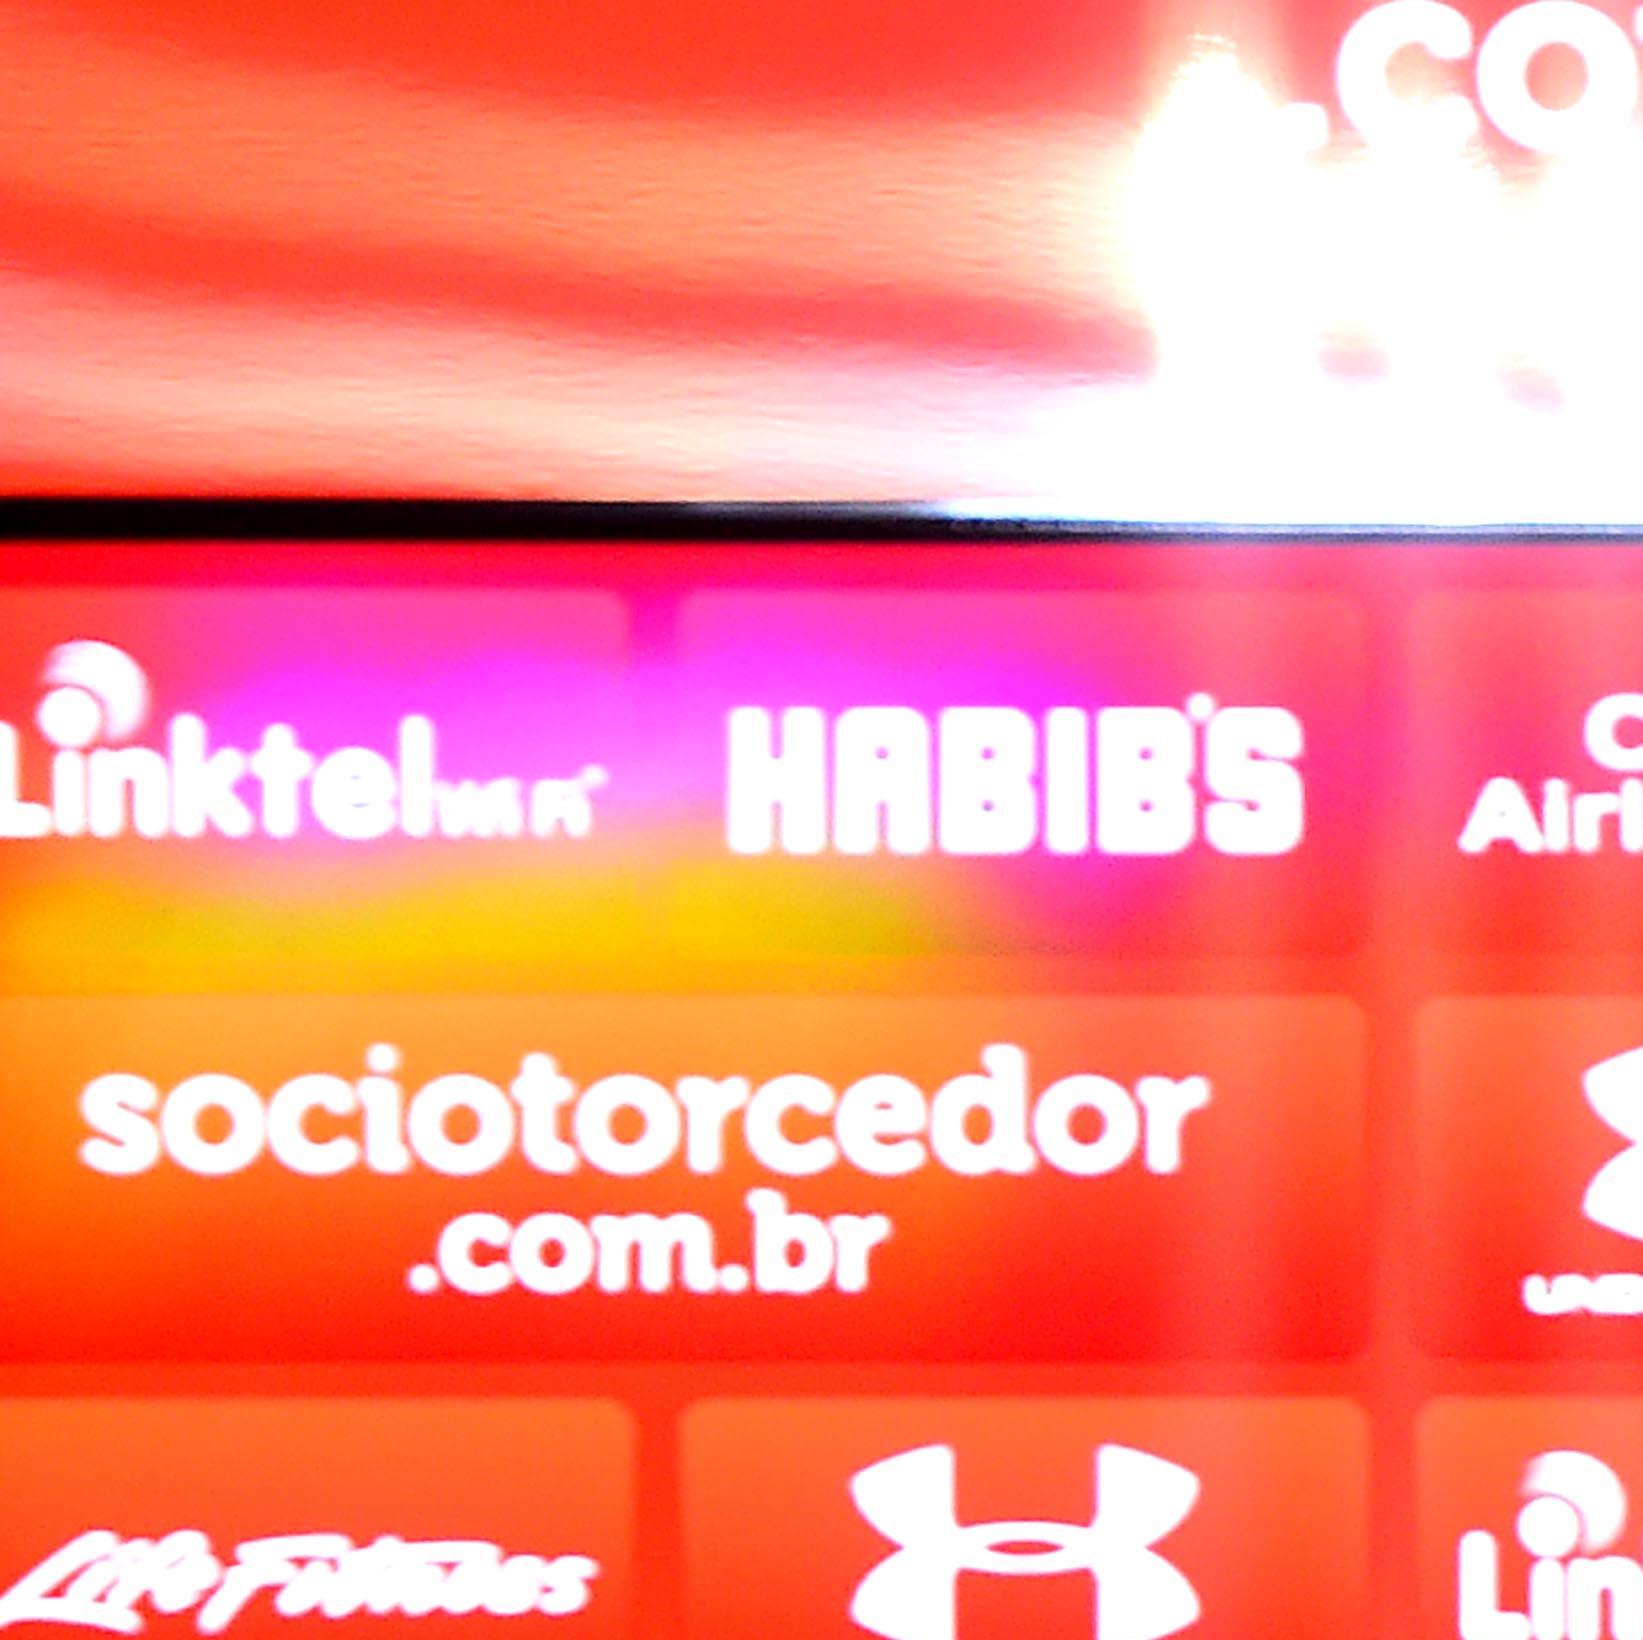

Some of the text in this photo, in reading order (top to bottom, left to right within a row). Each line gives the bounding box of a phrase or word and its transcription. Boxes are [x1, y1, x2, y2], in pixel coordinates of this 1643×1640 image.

[719, 692, 1304, 858] HABIB'S
[80, 1043, 1212, 1176] sociotorcedor
[408, 1188, 891, 1294] .com.br
